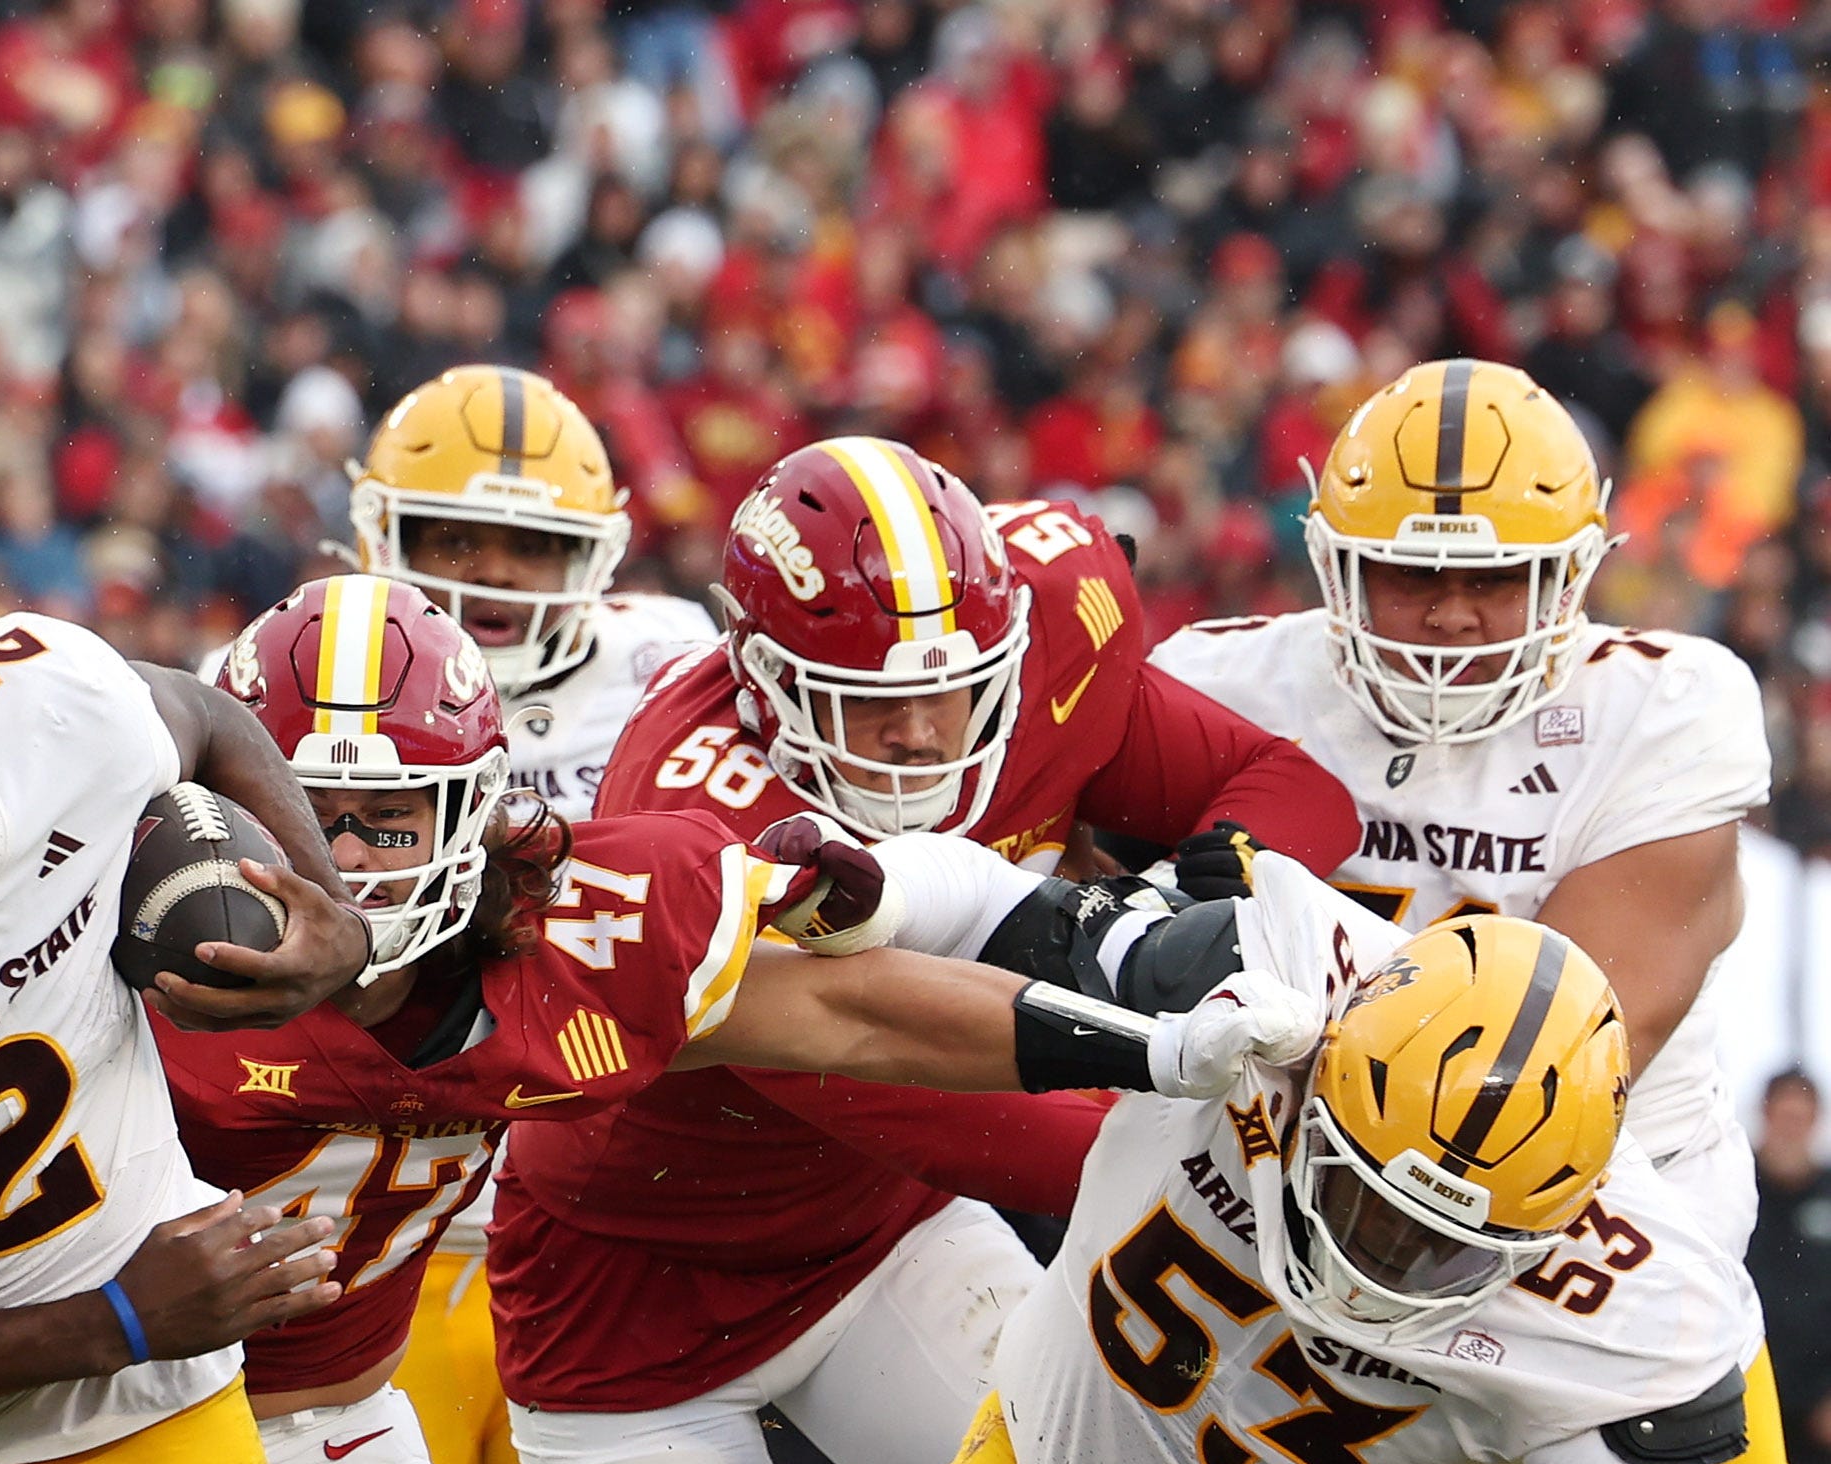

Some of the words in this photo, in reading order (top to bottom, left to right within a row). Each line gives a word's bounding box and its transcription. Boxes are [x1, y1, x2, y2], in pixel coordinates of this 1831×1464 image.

[1410, 520, 1435, 533] SUN
[1437, 520, 1478, 534] DEVILS
[655, 726, 777, 810] 58
[376, 831, 414, 848] 15:13
[1422, 822, 1548, 876] STATE
[544, 858, 651, 971] 47
[236, 1056, 301, 1100] XII
[232, 1129, 493, 1296] 47
[1407, 1164, 1434, 1189] SUN
[1432, 1178, 1476, 1209] DEVILS
[1512, 1197, 1654, 1319] 53
